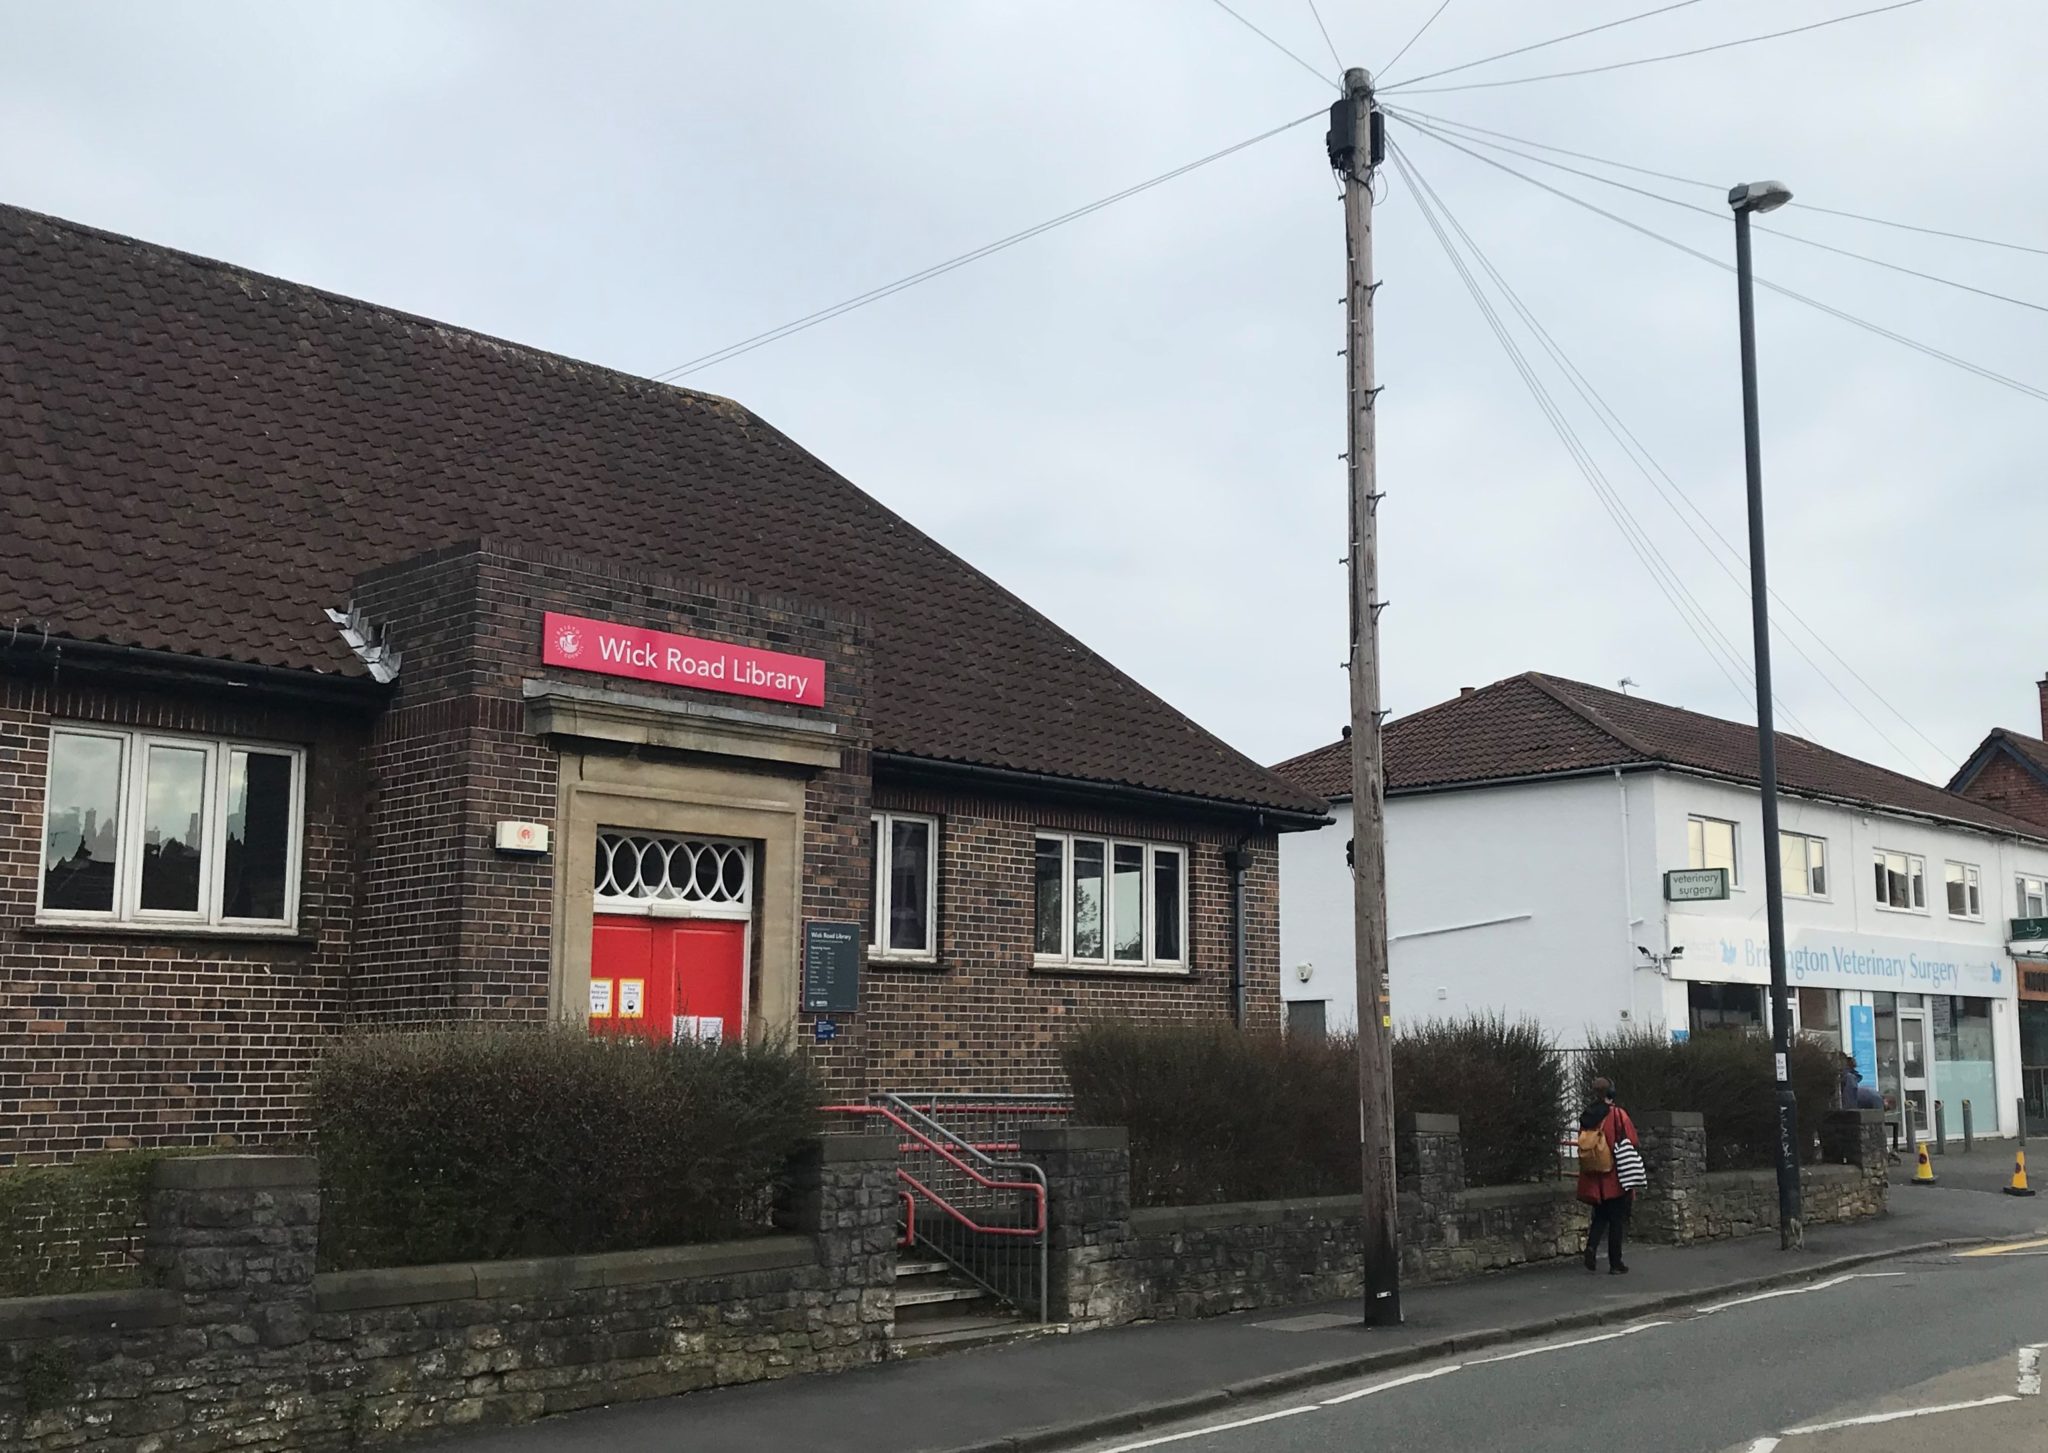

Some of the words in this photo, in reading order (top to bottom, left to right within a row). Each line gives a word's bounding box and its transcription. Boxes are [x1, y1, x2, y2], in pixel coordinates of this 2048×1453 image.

[599, 635, 658, 669] Wick
[667, 647, 725, 680] Road
[733, 658, 808, 698] Library
[1672, 873, 1719, 884] veterinary
[1679, 886, 1714, 897] surgery
[836, 932, 852, 941] Library
[1744, 938, 1830, 981] Brington
[1832, 946, 1906, 987] Veterinary
[1910, 952, 1960, 990] Surgery
